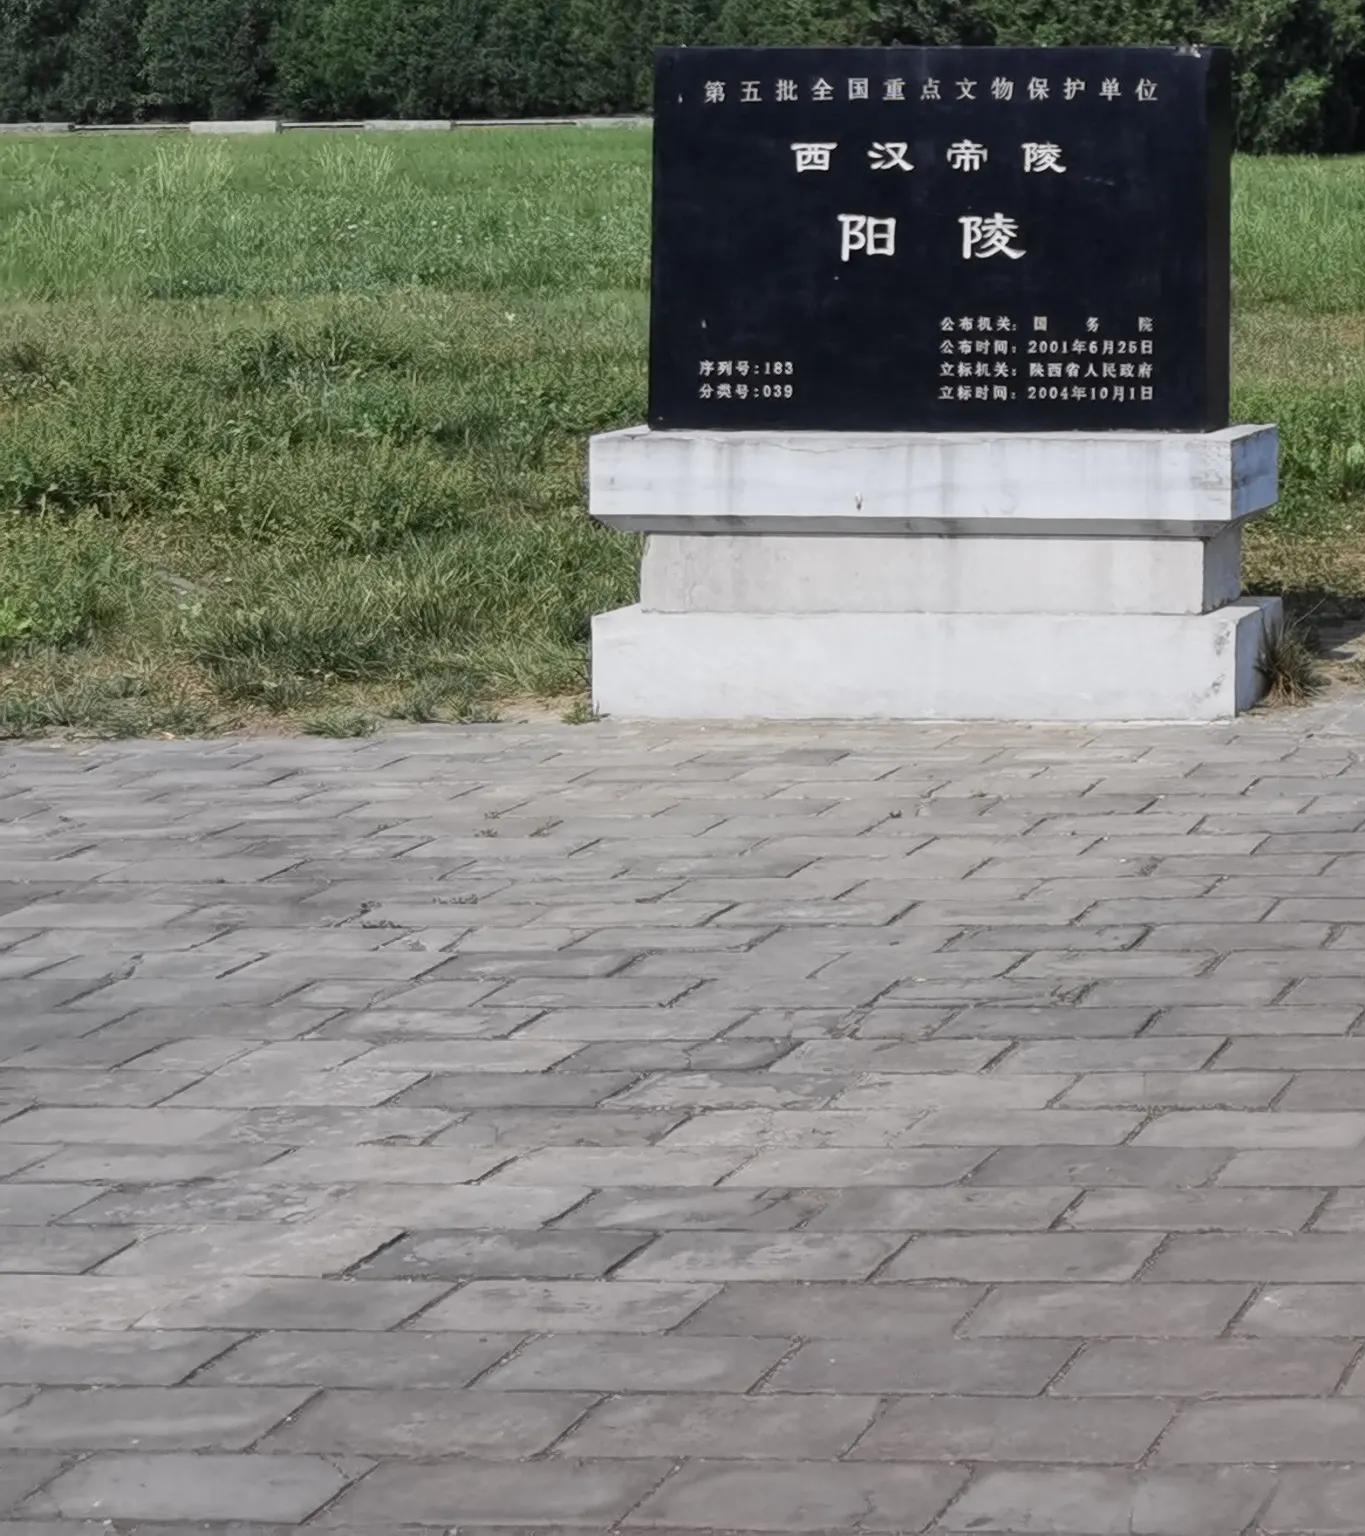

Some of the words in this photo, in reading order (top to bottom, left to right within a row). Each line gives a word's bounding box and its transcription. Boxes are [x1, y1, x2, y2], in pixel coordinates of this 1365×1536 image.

[704, 76, 1158, 104] 第五批全国重点文物保护单位
[790, 138, 1067, 174] 西汉帝陵
[836, 211, 1027, 262] 阳陵
